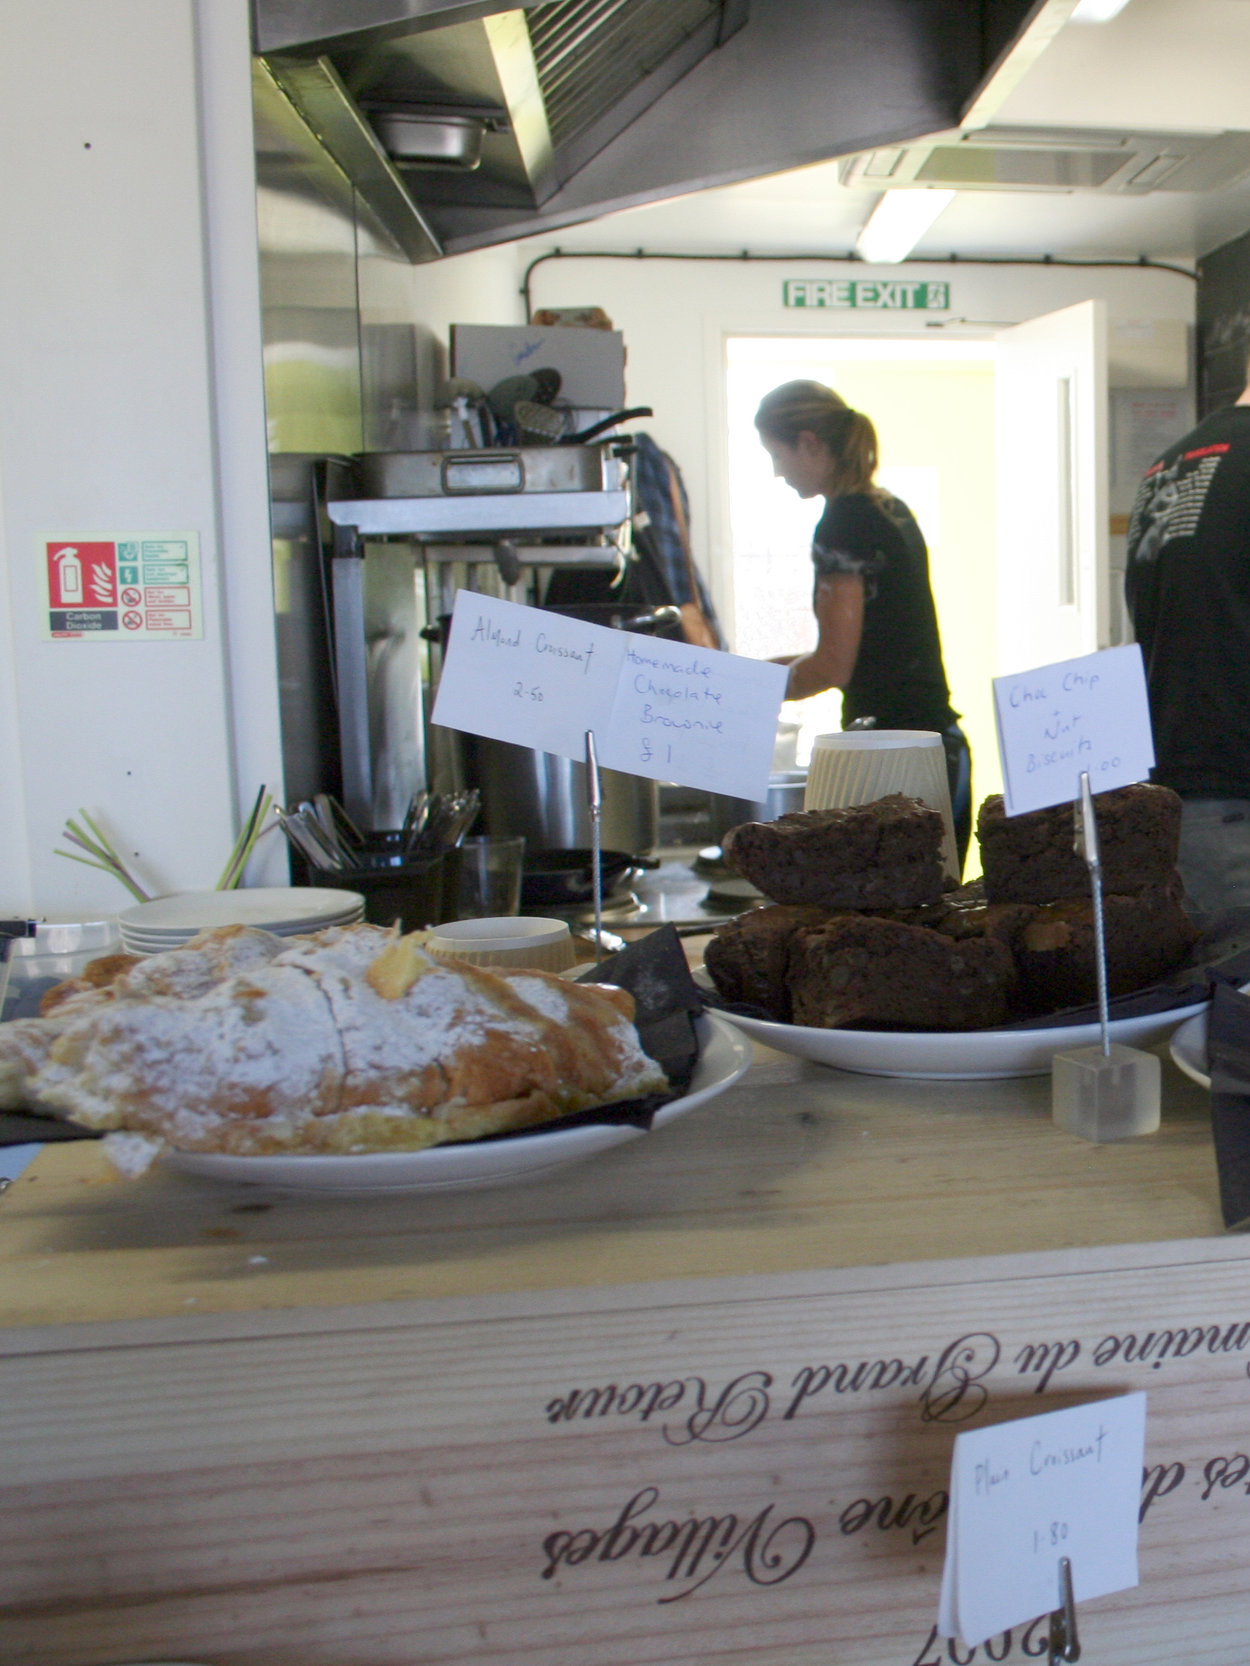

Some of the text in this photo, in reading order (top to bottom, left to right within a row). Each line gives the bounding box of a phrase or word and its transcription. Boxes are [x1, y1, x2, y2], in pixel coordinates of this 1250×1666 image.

[786, 281, 922, 309] FIRE EXIT
[65, 612, 102, 621] Carbon
[66, 621, 102, 630] Dioxide
[627, 649, 712, 679] Homemade
[1062, 672, 1100, 691] Chip
[640, 703, 723, 734] Brownie
[783, 1332, 1001, 1424] Grand
[1014, 1338, 1081, 1394] du
[545, 1370, 774, 1447] Retour
[1029, 1424, 1108, 1477] Croissant
[1139, 1461, 1186, 1525] d
[541, 1486, 816, 1604] Villages
